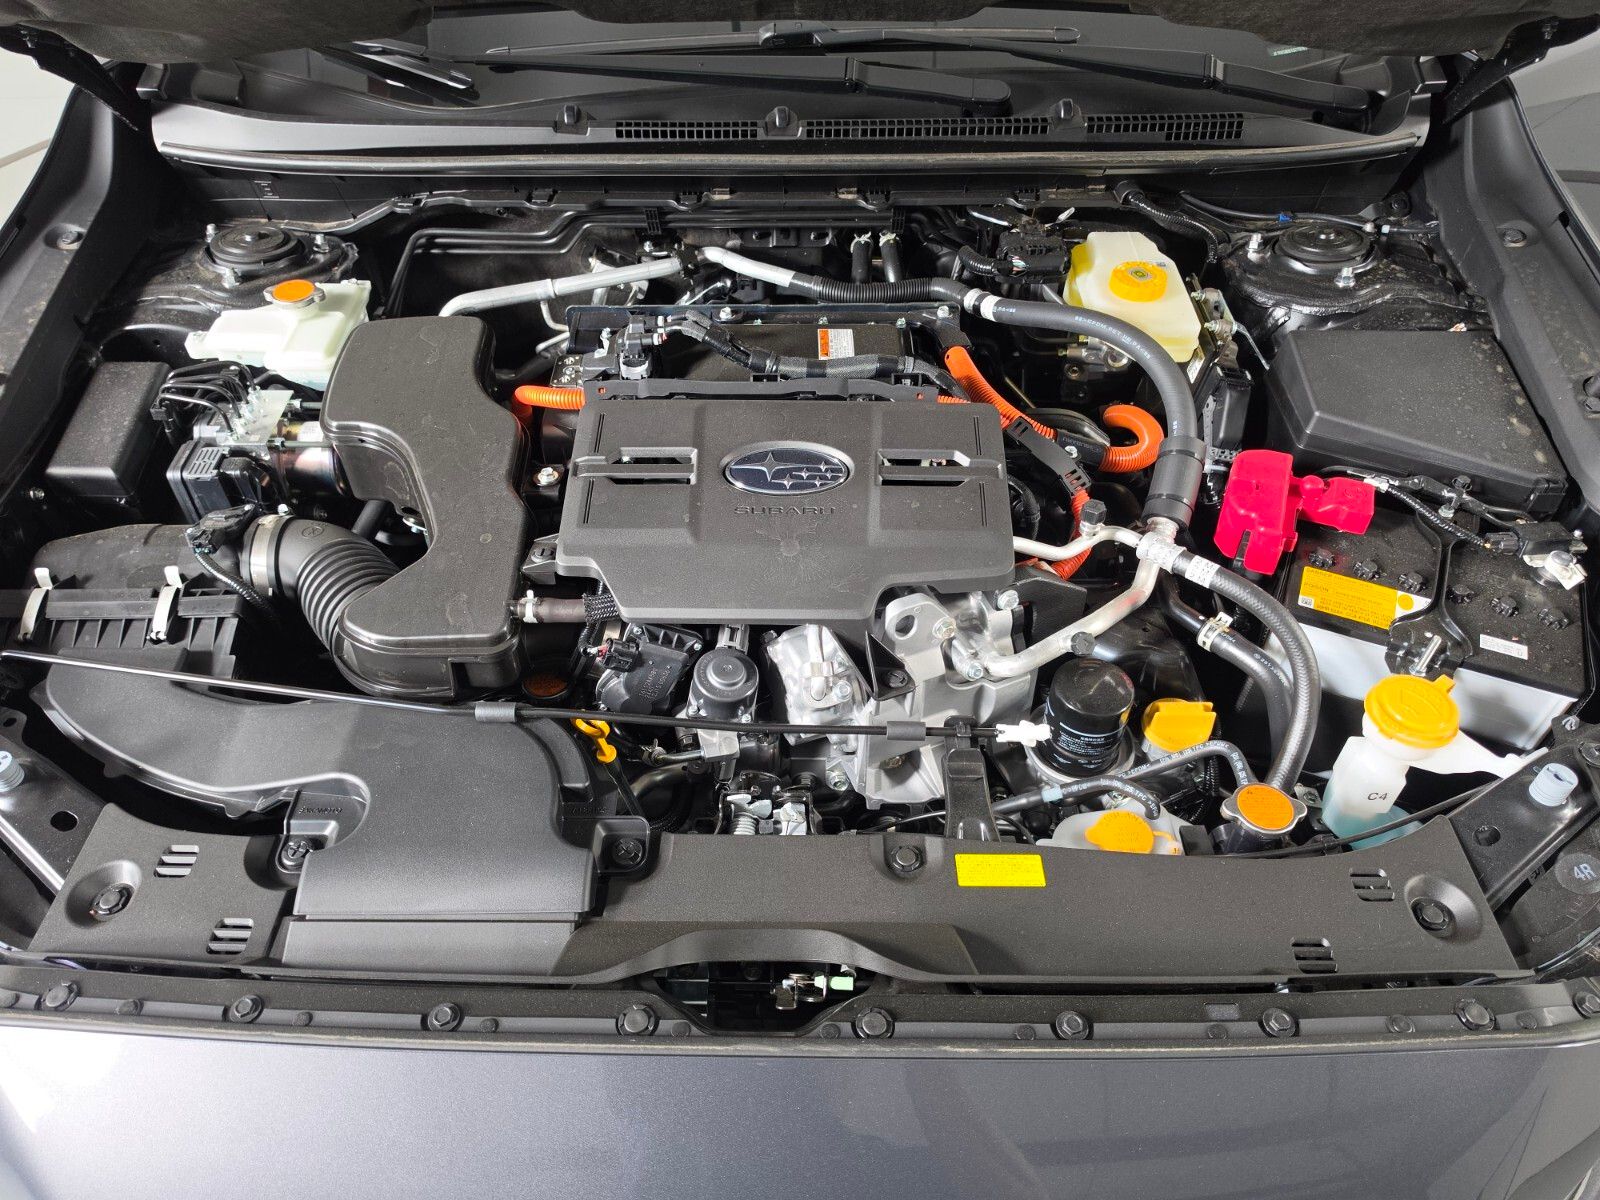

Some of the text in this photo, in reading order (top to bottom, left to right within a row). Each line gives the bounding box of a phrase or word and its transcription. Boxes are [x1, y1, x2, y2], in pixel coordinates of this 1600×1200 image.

[734, 505, 836, 515] SUBARU
[1367, 792, 1388, 801] C4
[1573, 863, 1597, 881] 4R
